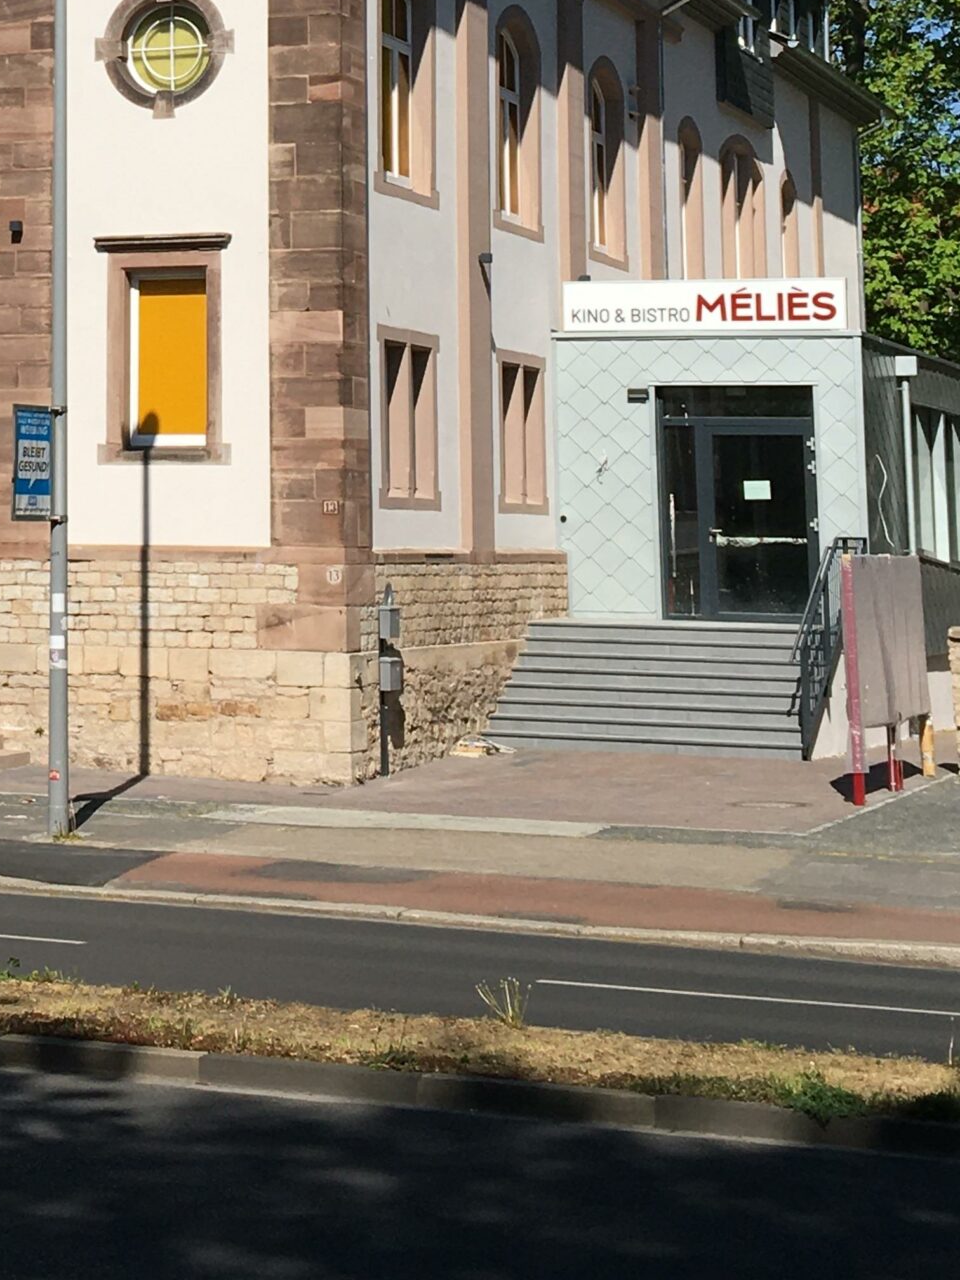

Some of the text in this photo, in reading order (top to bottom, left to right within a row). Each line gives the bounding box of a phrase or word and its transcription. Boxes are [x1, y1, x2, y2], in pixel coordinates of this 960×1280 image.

[571, 286, 837, 323] KINO & BISTRO MÉLIÈS
[22, 446, 46, 458] BLEIBT
[328, 569, 340, 581] 13
